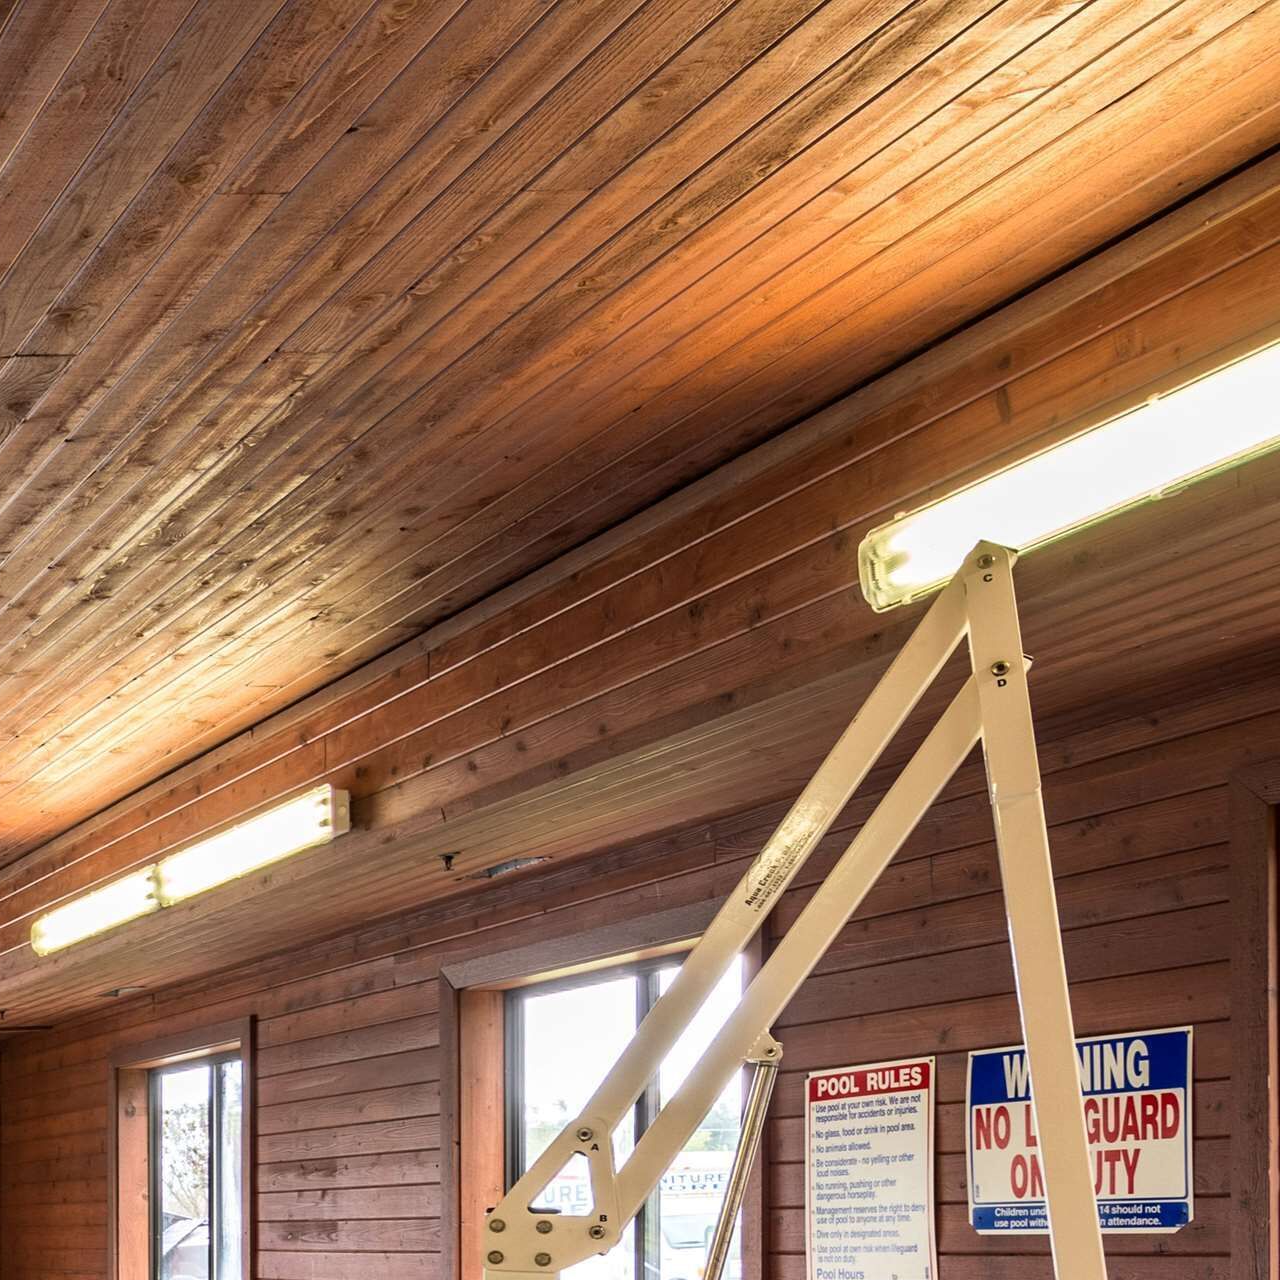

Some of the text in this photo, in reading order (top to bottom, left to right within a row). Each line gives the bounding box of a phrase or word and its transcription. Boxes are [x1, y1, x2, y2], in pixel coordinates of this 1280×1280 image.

[983, 574, 993, 582] C
[997, 679, 1007, 687] D
[745, 887, 762, 906] Aqua
[1003, 1039, 1149, 1099] WNING
[817, 1066, 922, 1097] POOL RULES
[816, 1104, 826, 1113] Use
[827, 1103, 840, 1114] pool
[841, 1102, 847, 1110] at
[848, 1101, 860, 1112] your
[861, 1100, 874, 1108] own
[889, 1096, 899, 1105] We
[911, 1094, 921, 1103] not
[816, 1113, 847, 1124] responsible
[857, 1109, 885, 1119] accidents
[975, 1092, 1180, 1150] NO LGUARD
[816, 1130, 824, 1138] No
[842, 1127, 855, 1136] food
[863, 1126, 878, 1135] drink
[879, 1124, 885, 1133] in
[886, 1123, 900, 1134] pool
[816, 1144, 824, 1153] No
[825, 1143, 847, 1152] animals
[816, 1159, 824, 1167] Be
[824, 1157, 858, 1167] considerate
[861, 1157, 870, 1165] no
[870, 1155, 890, 1166] yelling
[898, 1153, 914, 1162] other
[816, 1168, 829, 1177] loud
[1090, 1149, 1142, 1196] UTY
[816, 1182, 824, 1190] No
[849, 1180, 873, 1190] pushing
[881, 1179, 896, 1187] other
[816, 1192, 846, 1202] dangerous
[816, 1206, 852, 1217] Management
[853, 1206, 878, 1214] reserves
[878, 1205, 887, 1213] the
[911, 1204, 925, 1213] deny
[994, 1204, 1161, 1217] Children und 14 should not
[599, 1214, 607, 1222] B
[828, 1216, 835, 1224] of
[835, 1215, 849, 1226] pool
[849, 1215, 855, 1223] to
[994, 1219, 1008, 1227] use
[1010, 1218, 1027, 1229] pool
[1108, 1217, 1161, 1226] attendance.
[829, 1244, 841, 1255] pool
[816, 1268, 836, 1280] Pool
[838, 1268, 864, 1280] Hours
